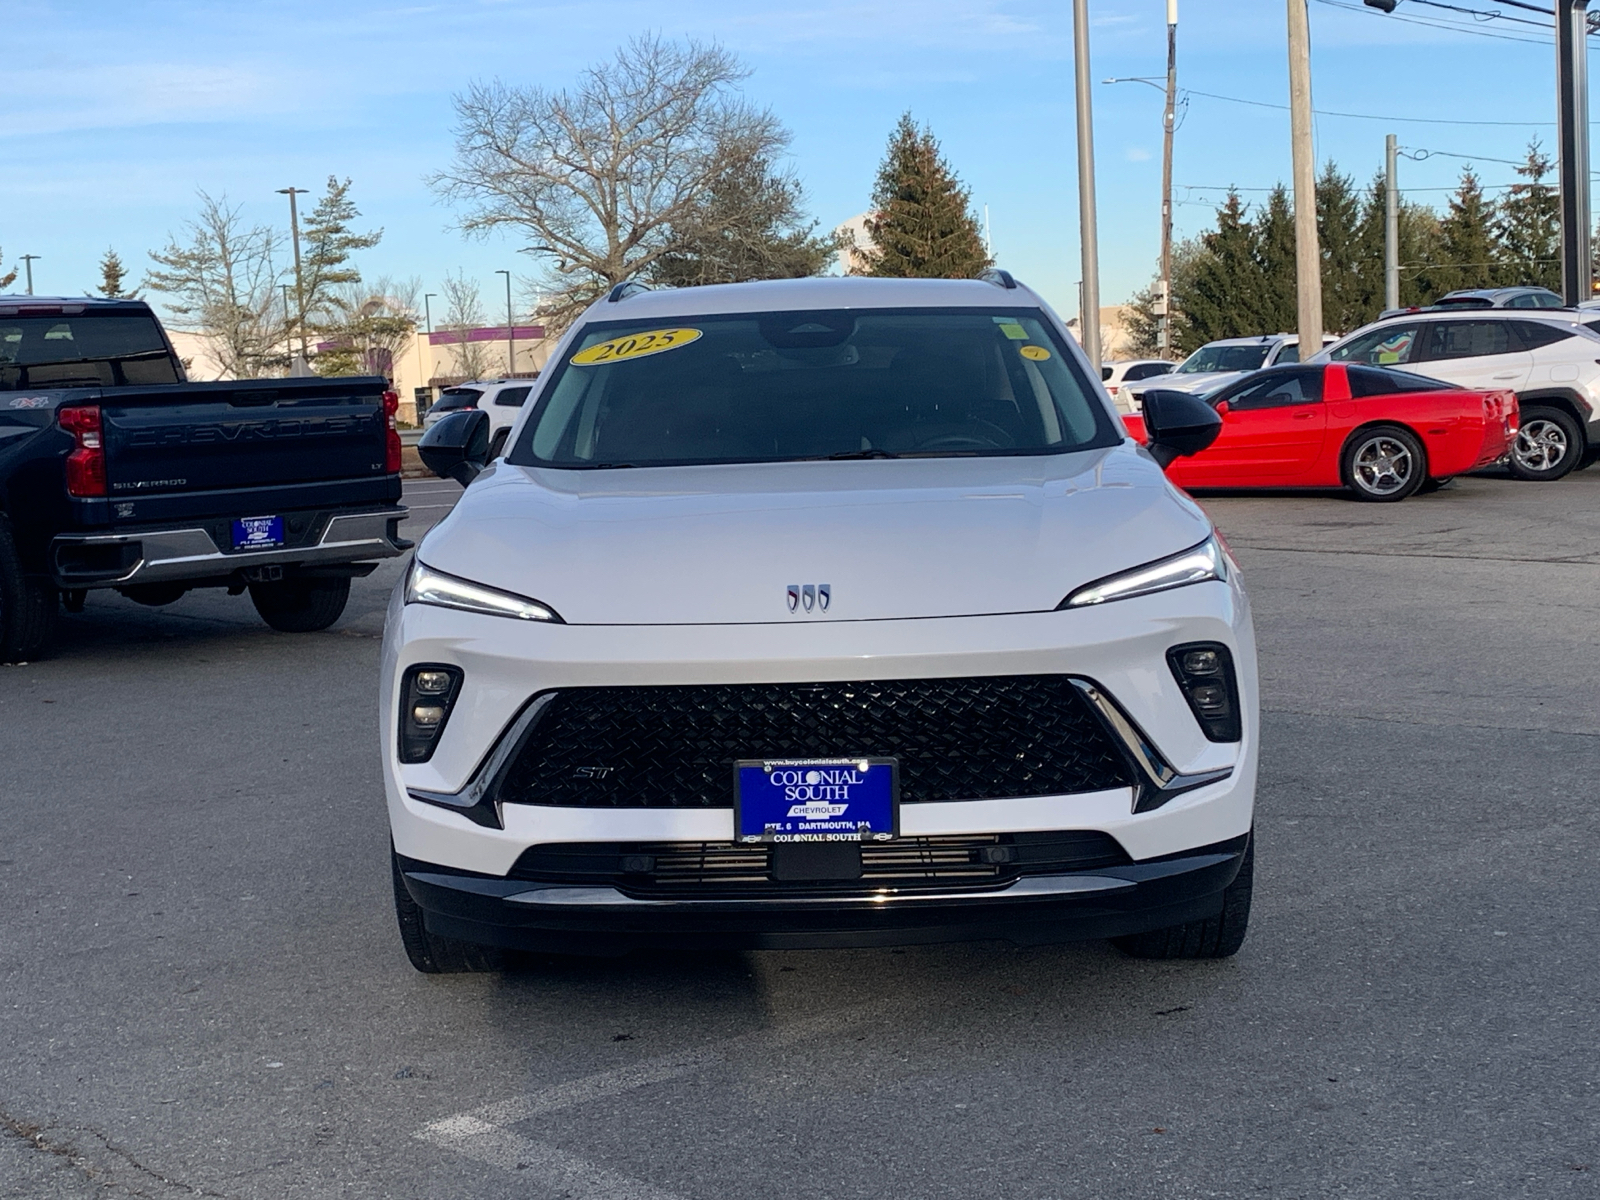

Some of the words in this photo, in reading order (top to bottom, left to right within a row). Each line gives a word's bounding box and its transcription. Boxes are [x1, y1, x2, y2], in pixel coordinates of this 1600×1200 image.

[592, 330, 679, 361] 2025
[113, 478, 187, 490] SILVERADO
[770, 770, 864, 786] COLONIAL
[785, 785, 850, 801] SOUTH
[793, 806, 842, 814] CHEVROLET
[798, 821, 856, 831] DARTMOUTH,
[773, 833, 825, 843] COLONIAL
[826, 833, 862, 841] SOUTH
